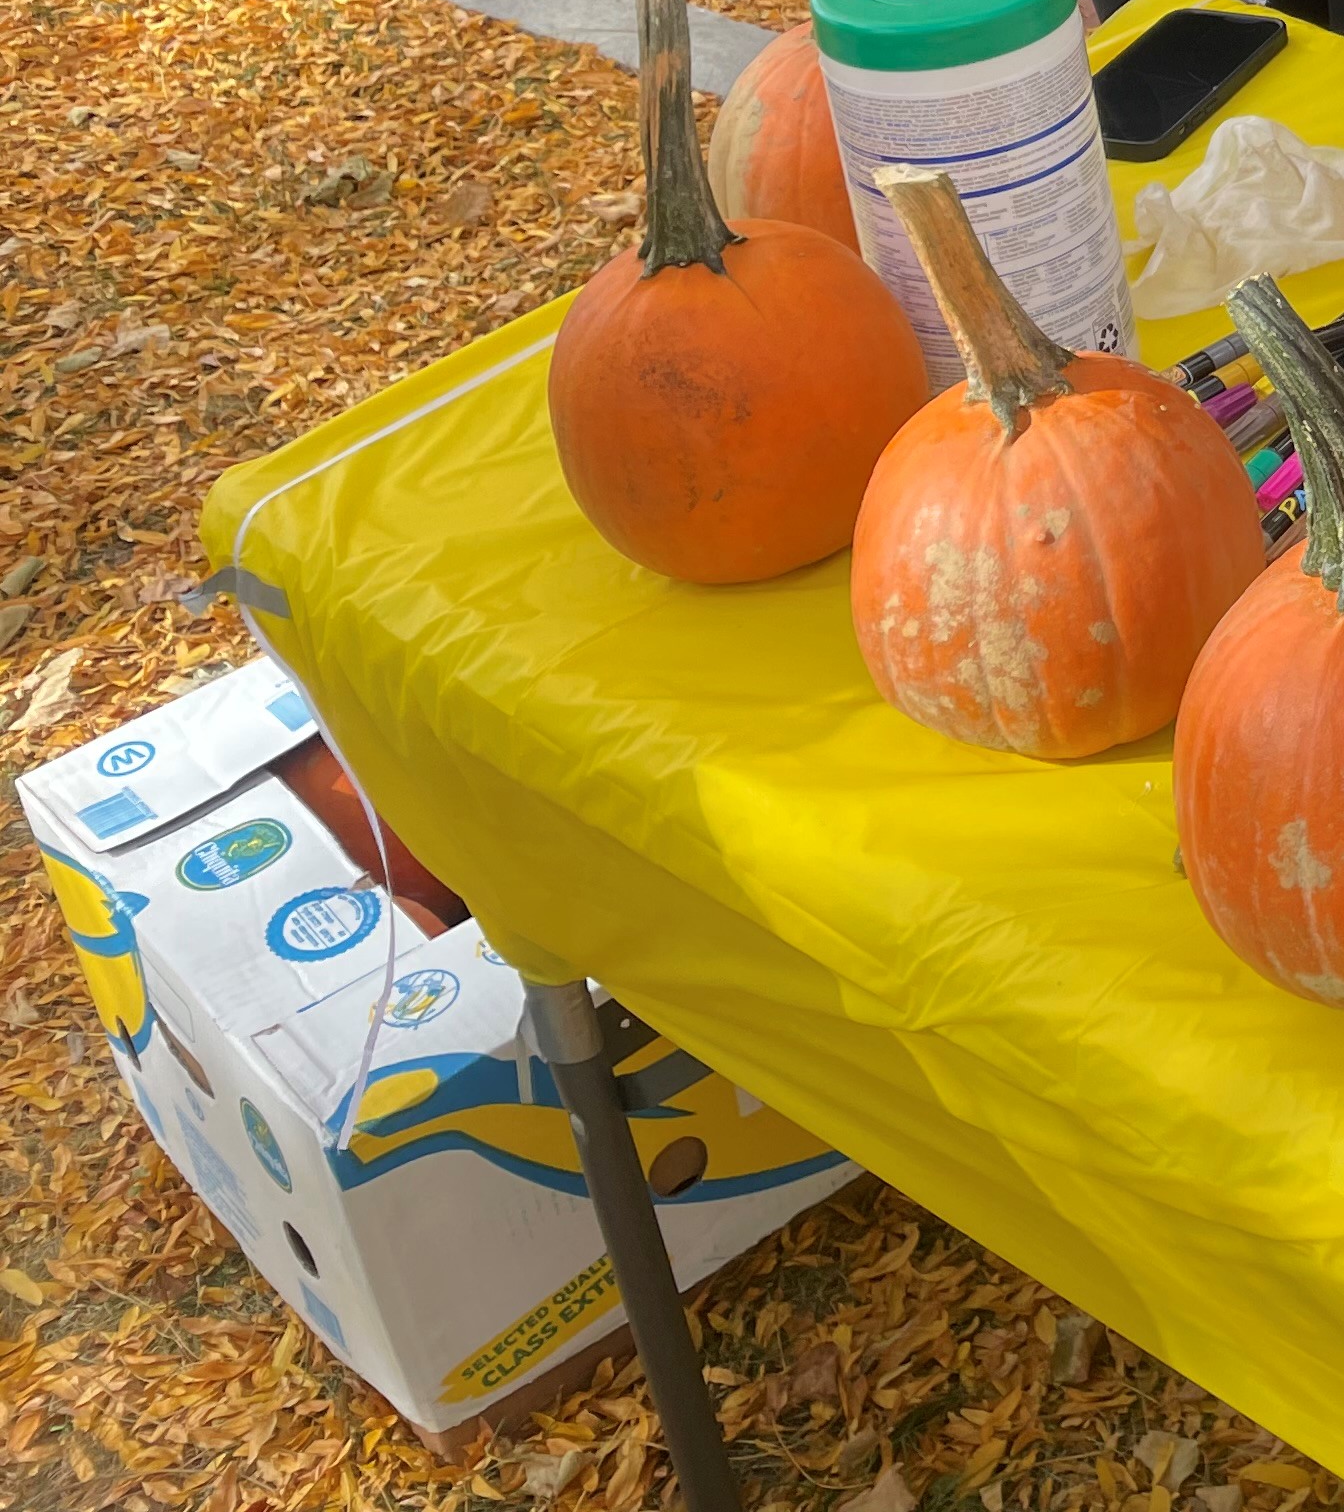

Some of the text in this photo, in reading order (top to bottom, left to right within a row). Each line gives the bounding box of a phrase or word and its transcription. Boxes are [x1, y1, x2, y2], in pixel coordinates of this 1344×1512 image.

[194, 841, 240, 886] Chiquita
[461, 1306, 549, 1380] SELECTED
[481, 1321, 558, 1387] CLASS
